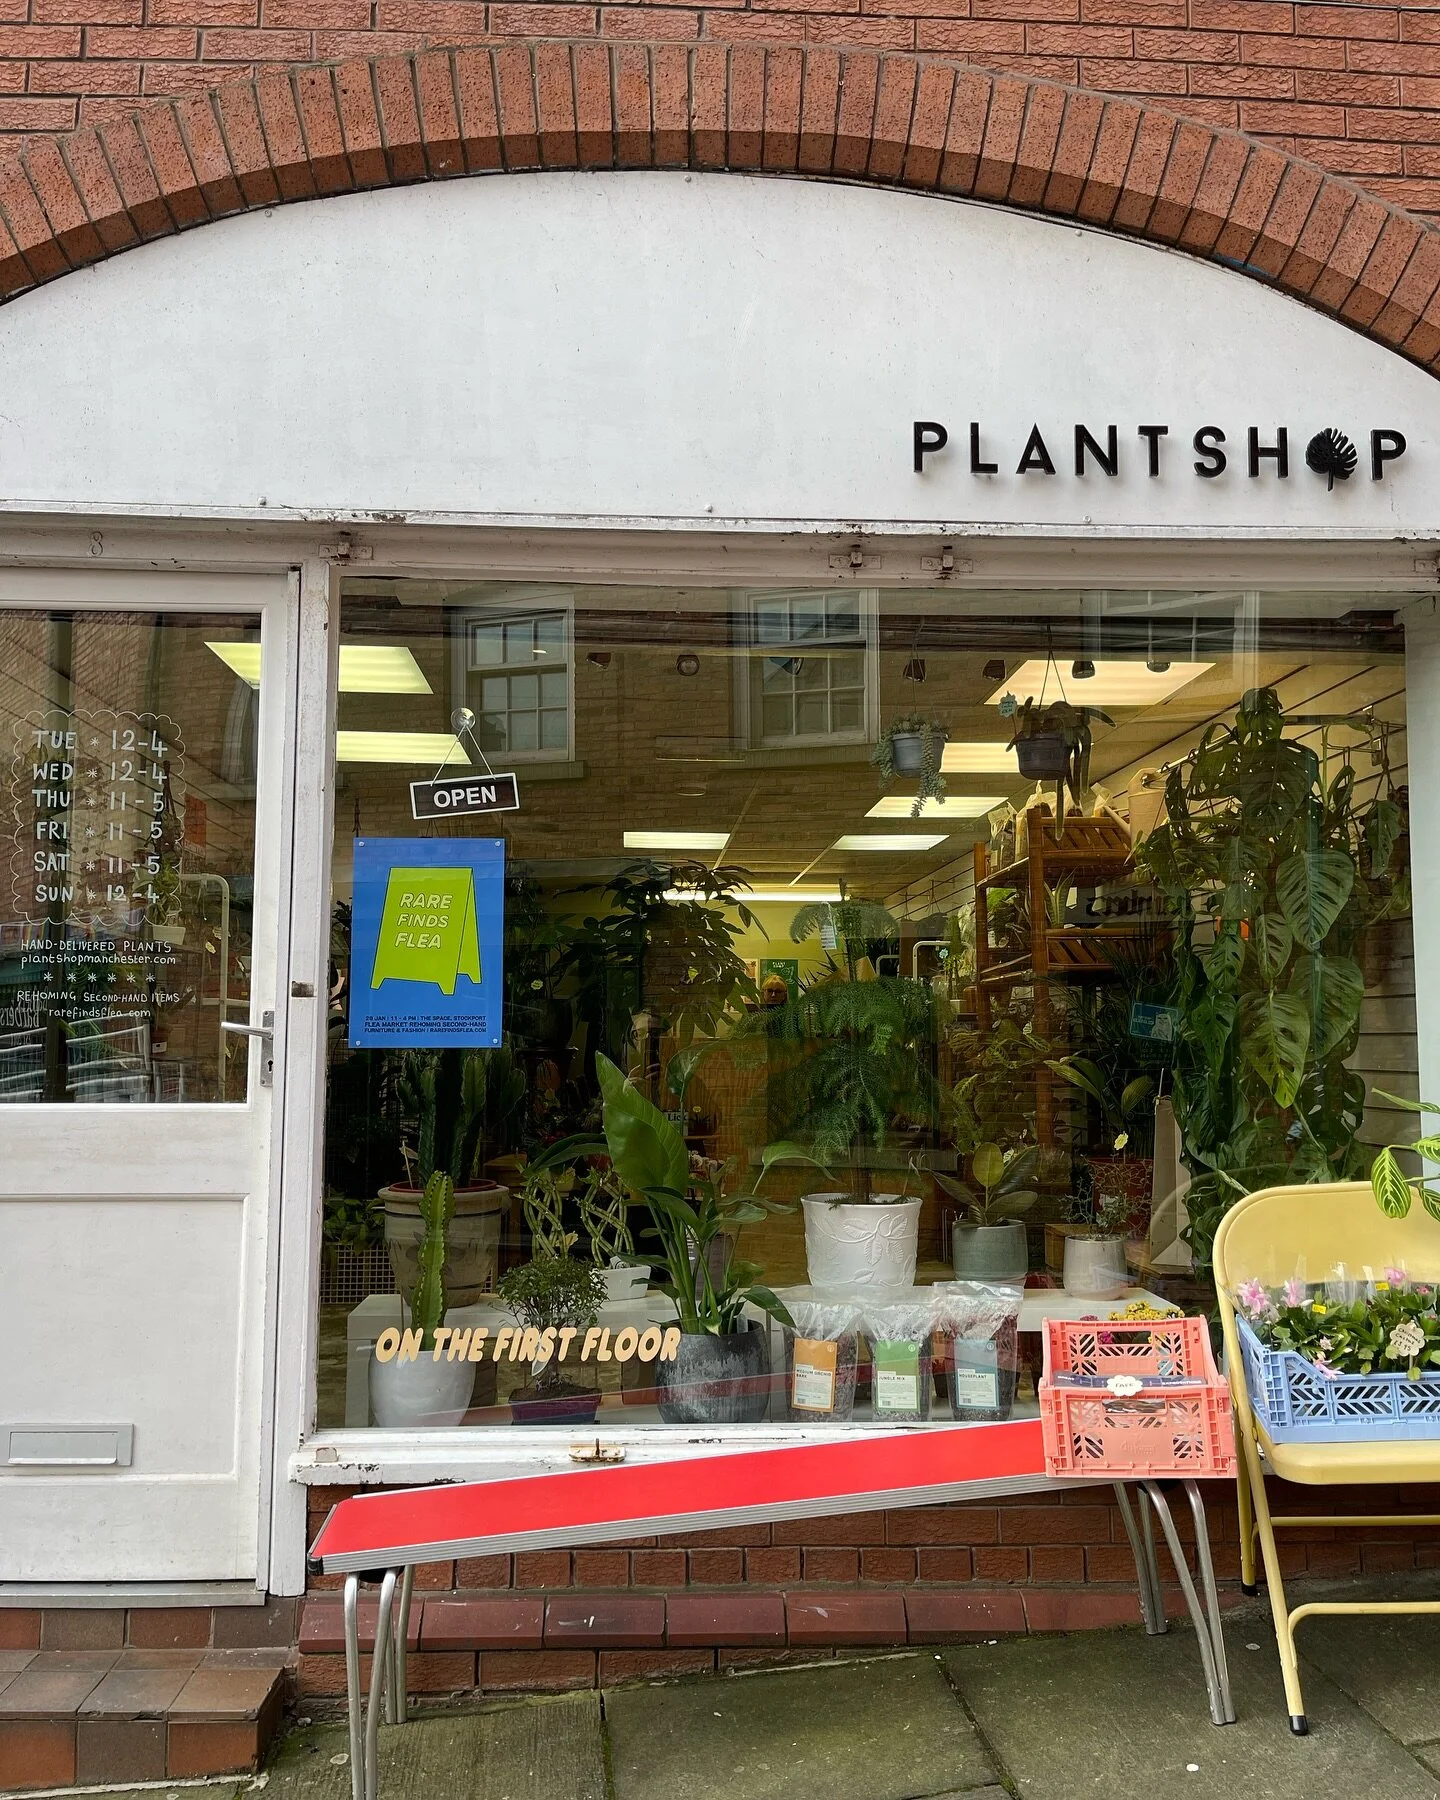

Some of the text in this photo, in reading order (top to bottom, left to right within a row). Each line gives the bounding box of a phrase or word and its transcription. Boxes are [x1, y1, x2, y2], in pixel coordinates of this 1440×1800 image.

[32, 730, 76, 750] TUE
[33, 763, 74, 781] WED
[32, 789, 71, 808] THU
[433, 785, 497, 808] OPEN
[36, 821, 68, 840] FRI
[34, 851, 70, 872] SAT
[35, 884, 74, 903] SUN
[400, 893, 453, 910] RARE
[397, 914, 449, 928] FINDS
[21, 939, 172, 953] HAND-DELIVERED PLANTS
[395, 932, 442, 949] FLEA
[21, 953, 176, 969] plantshopmanchester.com
[17, 990, 180, 1003] REHOMING SECOND-HAND ITEMS
[49, 1007, 151, 1019] rarefindsflea.com
[375, 1326, 682, 1363] ON THE FIRST FLOOR
